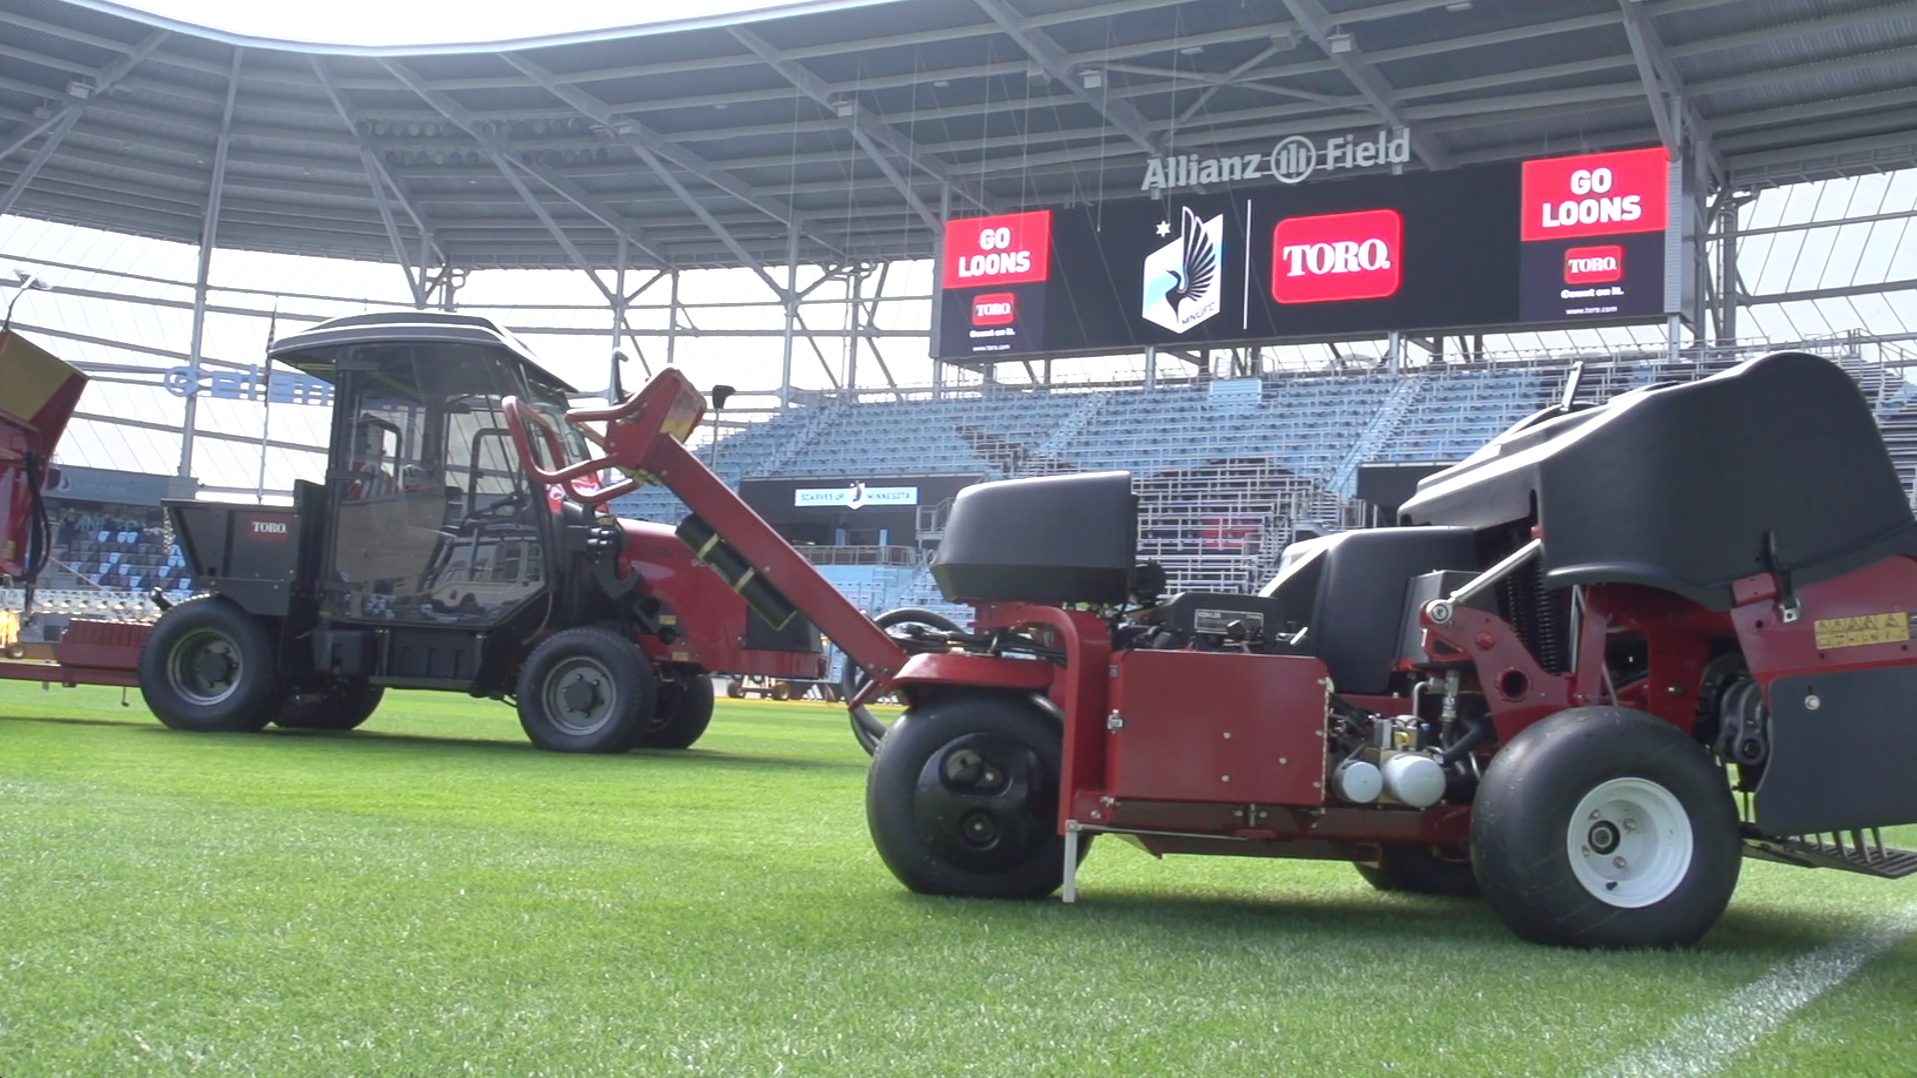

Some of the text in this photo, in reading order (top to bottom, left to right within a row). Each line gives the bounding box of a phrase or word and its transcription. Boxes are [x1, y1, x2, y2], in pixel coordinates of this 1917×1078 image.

[1141, 127, 1410, 190] Allianz Field
[1570, 167, 1612, 195] GO
[1542, 194, 1642, 228] LOONS
[980, 227, 1011, 250] GO
[958, 250, 1031, 278] LOONS
[976, 302, 1011, 317] TORO
[252, 521, 288, 534] TORO
